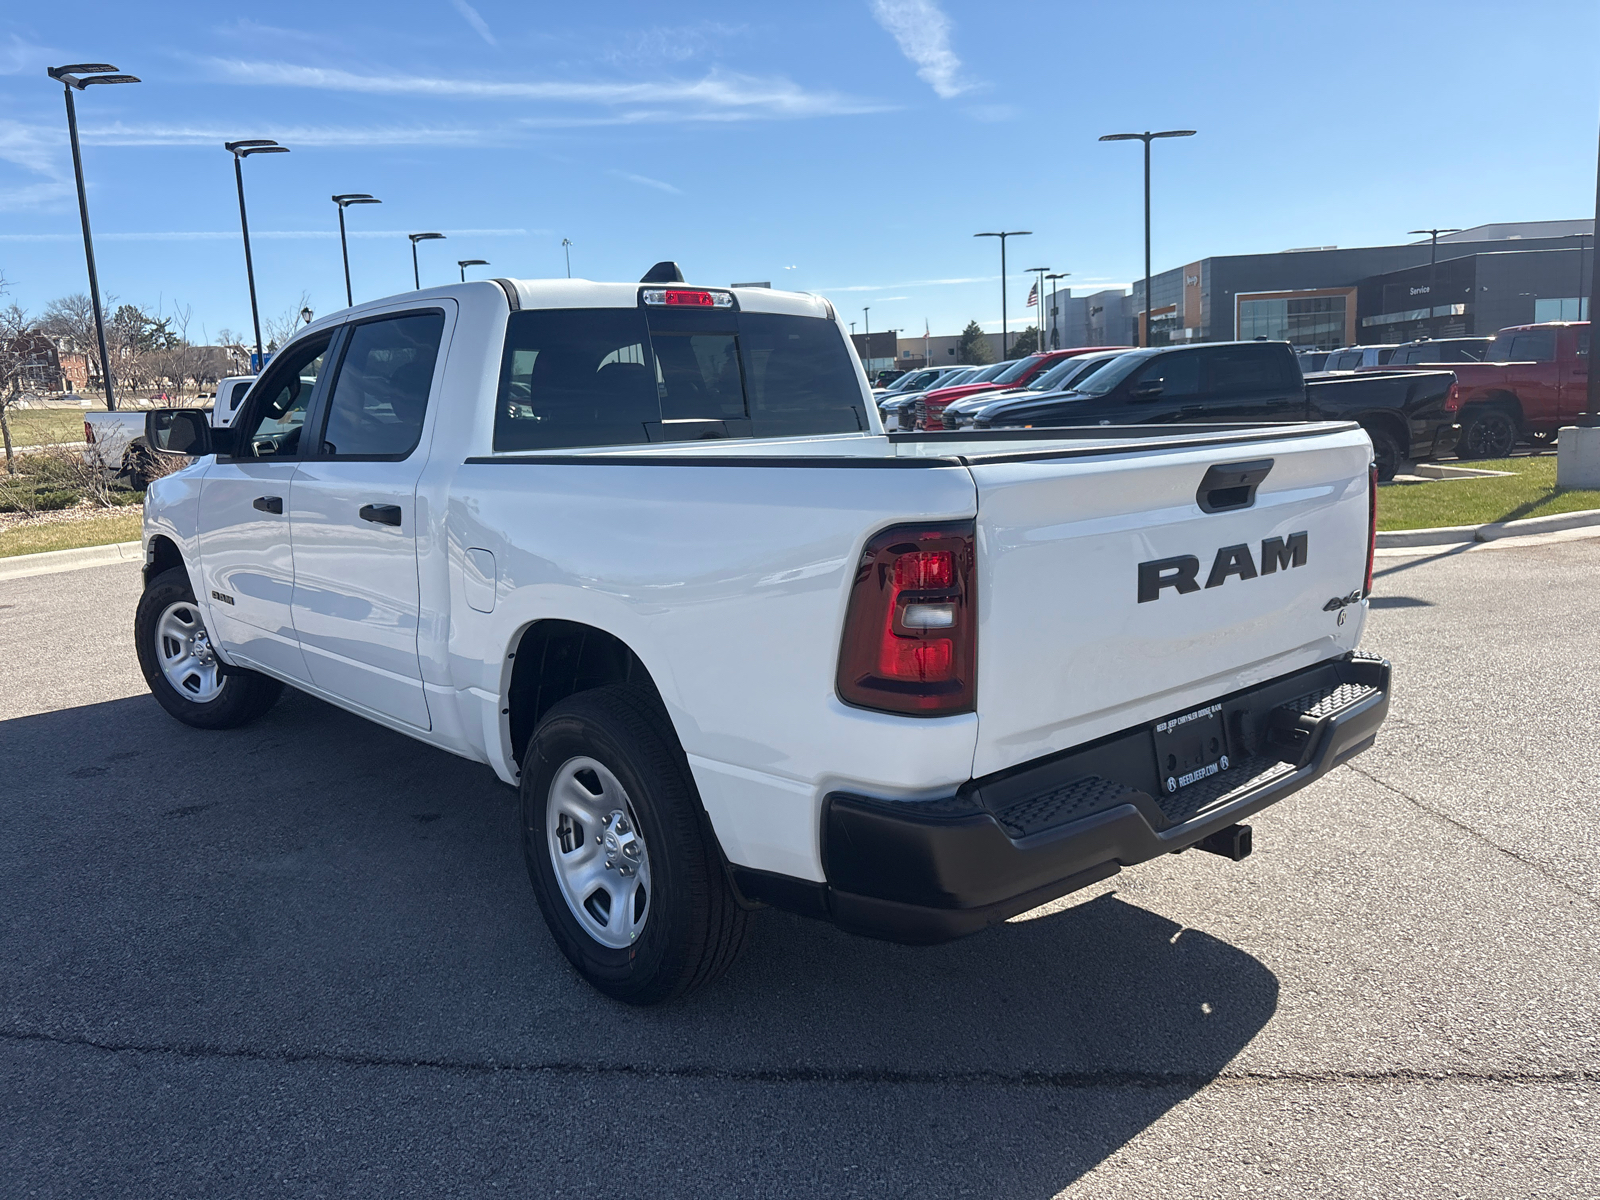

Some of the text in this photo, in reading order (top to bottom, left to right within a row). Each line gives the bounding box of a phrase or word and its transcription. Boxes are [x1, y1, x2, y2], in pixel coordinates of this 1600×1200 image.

[1409, 285, 1430, 296] Service
[1137, 530, 1308, 604] RAM
[211, 590, 235, 606] RAM
[1156, 703, 1222, 733] REED JEEP CHRYSLER DODGE RAM
[1178, 763, 1219, 788] REEDJEEP.COM
